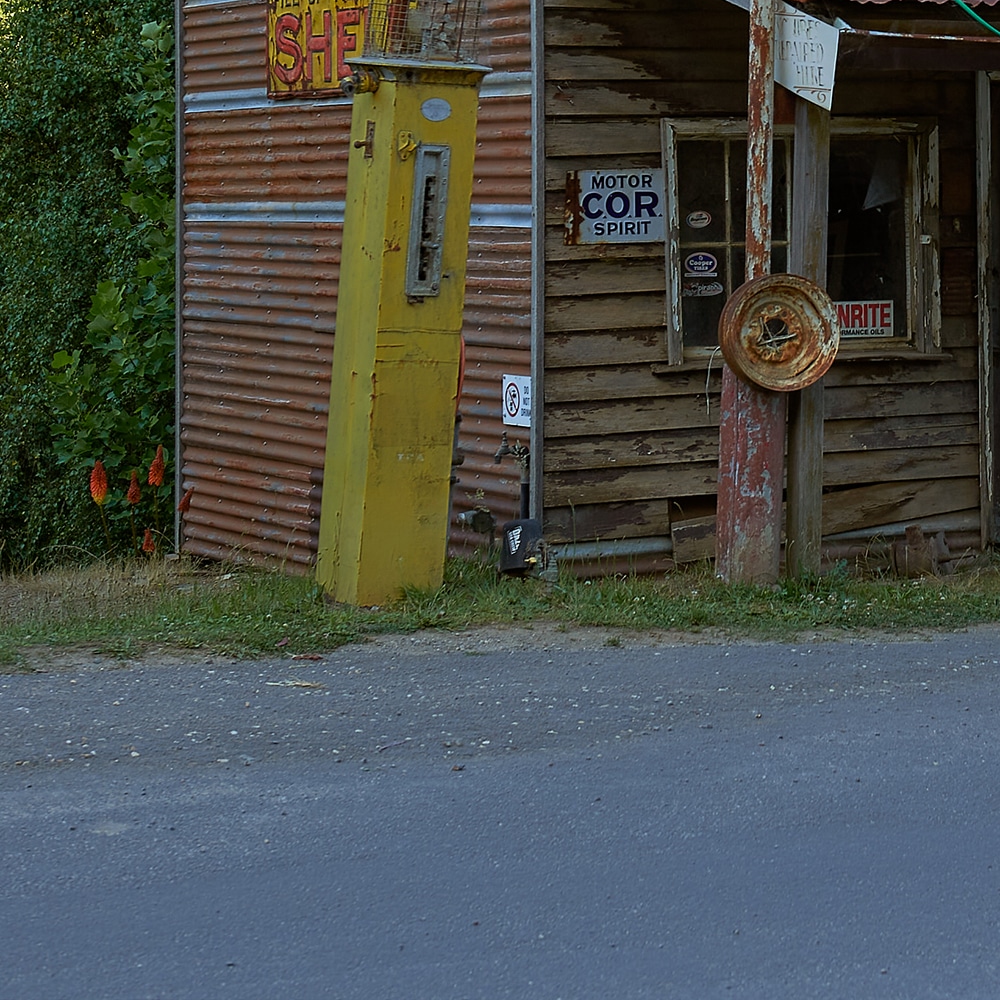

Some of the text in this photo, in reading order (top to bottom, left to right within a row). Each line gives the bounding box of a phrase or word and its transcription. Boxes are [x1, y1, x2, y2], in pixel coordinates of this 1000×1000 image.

[275, 8, 368, 85] SHE
[591, 174, 652, 190] MOTOR
[582, 191, 663, 219] C.O.R.
[594, 220, 651, 236] SPIRIT
[689, 260, 713, 268] Cooper
[837, 303, 891, 328] NRITE
